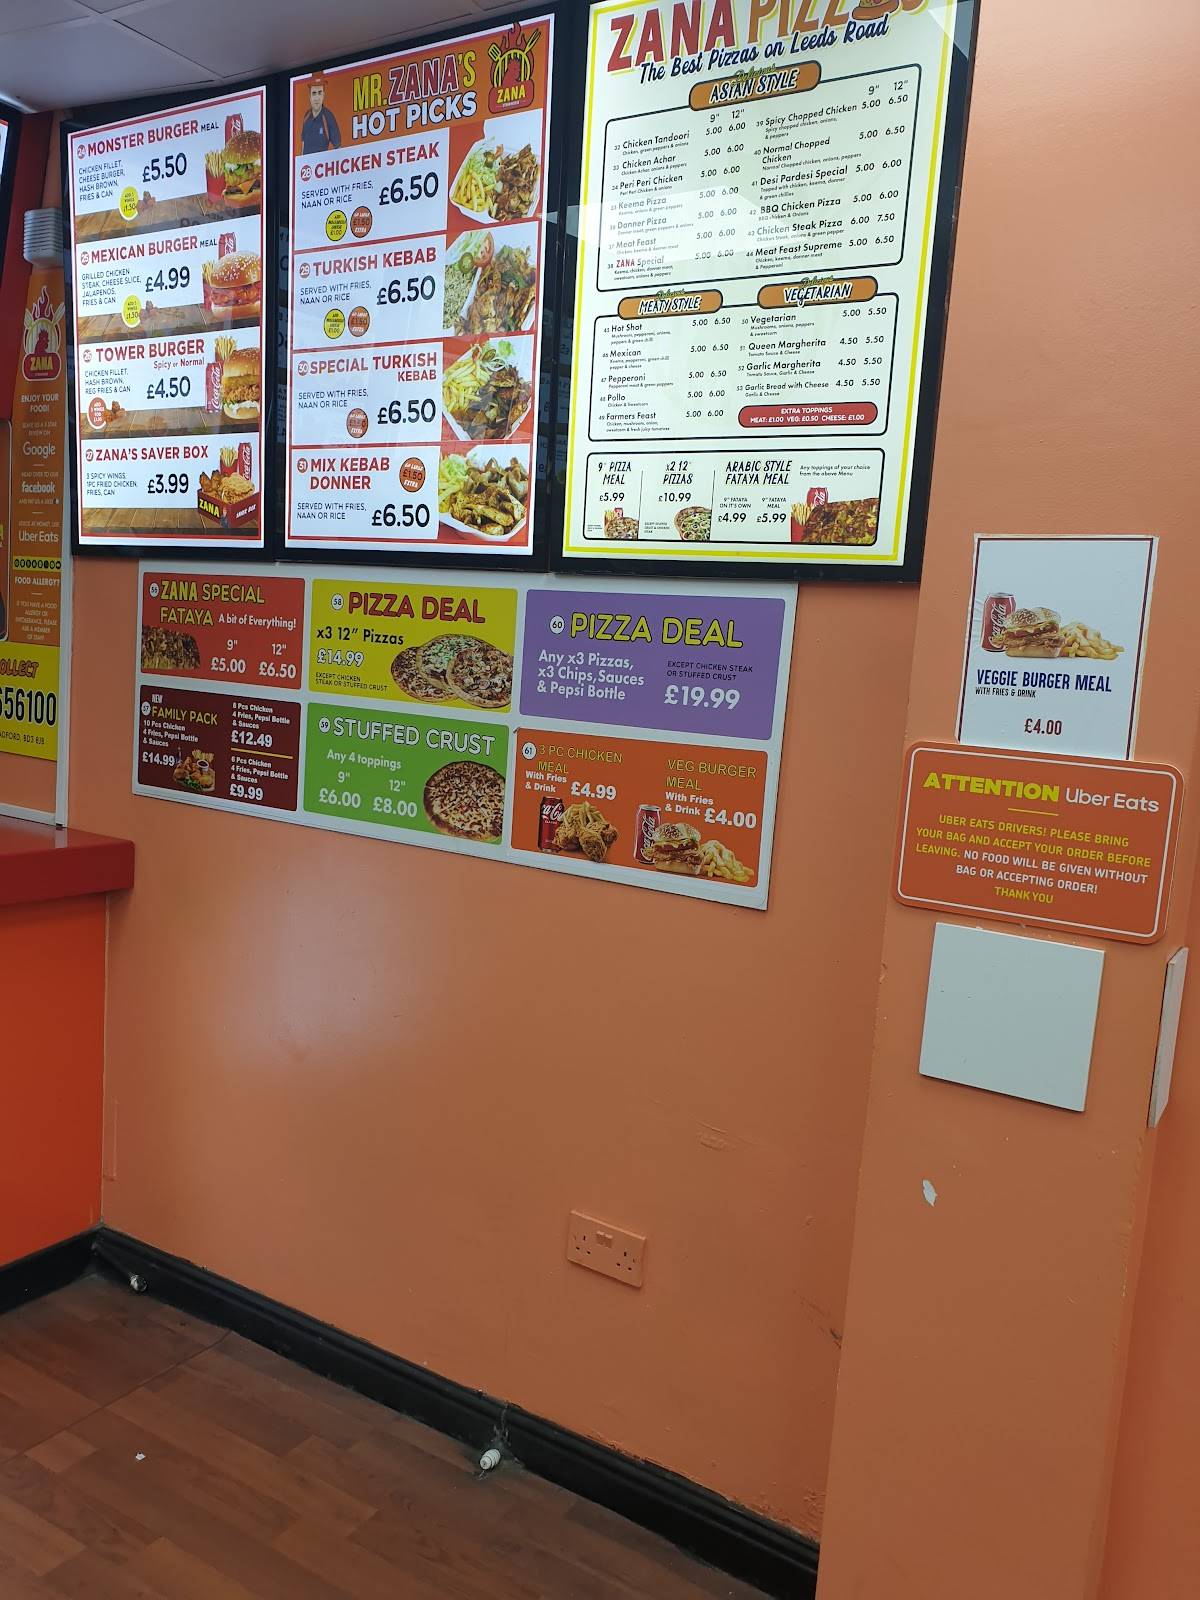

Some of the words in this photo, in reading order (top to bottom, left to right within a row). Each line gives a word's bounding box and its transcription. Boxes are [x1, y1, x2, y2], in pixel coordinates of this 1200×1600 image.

[607, 0, 735, 72] ZANA
[640, 62, 665, 84] The
[672, 54, 702, 77] Best
[709, 46, 758, 69] Pizzas
[765, 41, 783, 58] on
[791, 25, 836, 54] Leeds
[844, 15, 889, 44] Road
[497, 85, 525, 103] ZANA
[710, 80, 754, 104] ASIAN
[757, 70, 799, 95] STYLE
[862, 100, 880, 109] 5.00
[889, 94, 908, 105] 6.50
[352, 108, 400, 139] HOT
[406, 91, 477, 128] PICKS
[766, 116, 786, 126] Spicy
[788, 110, 823, 123] Chopped
[826, 105, 857, 115] Chicken
[88, 132, 144, 156] MONSTER
[148, 120, 198, 143] BURGER
[201, 122, 219, 132] MEAL
[623, 139, 652, 149] Chicken
[655, 131, 689, 143] Tandoori
[142, 153, 187, 183] £5.50
[314, 153, 381, 178] CHICKEN
[387, 142, 439, 166] STEAK
[760, 175, 778, 185] Desi
[781, 171, 812, 183] Pardesi
[816, 165, 848, 179] Special
[302, 188, 329, 199] SERVED
[331, 184, 350, 193] WITH
[379, 172, 439, 205] £6.50
[302, 200, 322, 208] NAAN
[337, 195, 352, 203] RICE
[92, 244, 144, 263] MEXICAN
[148, 236, 198, 256] BURGER
[200, 239, 217, 248] MEAL
[313, 254, 377, 276] TURKISH
[383, 247, 436, 267] KEBAB
[145, 266, 190, 293] £4.99
[376, 275, 436, 305] £6.50
[785, 284, 851, 304] VEGETARIAN
[96, 345, 144, 362] TOWER
[149, 339, 205, 358] BURGER
[310, 358, 368, 374] SPECIAL
[373, 352, 437, 369] TURKISH
[398, 369, 436, 382] KEBAB
[146, 376, 191, 399] £4.50
[377, 398, 436, 424] £6.50
[23, 441, 56, 458] Google
[95, 448, 138, 461] ZANA'S
[141, 446, 179, 460] SAVER
[183, 445, 208, 458] BOX
[311, 458, 336, 472] MIX
[340, 457, 390, 471] KEBAB
[726, 461, 760, 471] ARABIC
[764, 461, 792, 471] STYLE
[21, 482, 55, 493] facebook
[148, 473, 189, 494] £3.99
[310, 476, 371, 489] DONNER
[725, 473, 759, 485] FATAYA
[763, 473, 789, 485] MEAL
[371, 503, 430, 527] £6.50
[19, 531, 37, 542] Uber
[39, 531, 59, 542] Eats
[161, 581, 197, 601] ZANA
[202, 584, 265, 603] SPECIAL
[160, 607, 213, 626] FATAYA
[348, 592, 414, 618] PIZZA
[421, 596, 485, 623] DEAL
[219, 614, 224, 622] A
[226, 614, 236, 623] bit
[239, 615, 248, 624] of
[249, 615, 296, 631] Everything!
[570, 612, 652, 643] PIZZA
[662, 617, 743, 648] DEAL
[317, 627, 333, 639] x3
[363, 629, 403, 645] Pizzas
[211, 657, 246, 673] £5.00
[317, 649, 364, 667] £14.99
[538, 650, 563, 666] Any
[568, 653, 584, 664] x3
[588, 652, 634, 670] Pizzas,
[259, 661, 296, 678] £6.50
[977, 669, 1018, 686] VEGGIE
[1023, 672, 1069, 689] BURGER
[1075, 674, 1112, 692] MEAL
[537, 681, 547, 693] &
[550, 683, 584, 698] Pepsi
[588, 684, 625, 701] Bottle
[664, 685, 740, 710] £19.99
[975, 687, 990, 695] WITH
[992, 688, 1008, 696] FRIES
[1018, 690, 1036, 698] DRINK
[152, 706, 187, 721] FAMILY
[190, 711, 217, 725] PACK
[333, 717, 420, 746] STUFFED
[426, 729, 496, 756] CRUST
[1024, 718, 1062, 735] £4.00
[231, 730, 272, 747] £12.49
[142, 752, 175, 766] £14.99
[327, 750, 346, 763] Any
[349, 752, 355, 761] 4
[358, 753, 401, 771] toppings
[539, 745, 545, 754] 3
[549, 746, 563, 757] PC
[567, 748, 622, 764] CHICKEN
[538, 761, 568, 773] MEAL
[668, 759, 694, 772] VEG
[699, 762, 756, 779] BURGER
[230, 784, 263, 800] £9.99
[571, 781, 616, 800] £4.99
[666, 777, 702, 791] MEAL
[923, 772, 1059, 802] ATTENTION
[1066, 787, 1110, 807] Uber
[1114, 793, 1160, 812] Eats
[319, 788, 361, 808] £6.00
[373, 797, 417, 817] £8.00
[704, 808, 756, 828] £4.00
[939, 815, 966, 827] UBER
[970, 818, 994, 830] EATS
[998, 822, 1046, 836] DRIVERS!
[1050, 829, 1091, 842] PLEASE
[1095, 834, 1129, 847] BRING
[916, 827, 943, 839] YOUR
[946, 831, 966, 842] BAG
[969, 835, 990, 845] AND
[993, 838, 1031, 850] ACCEPT
[1035, 843, 1062, 855] YOUR
[1066, 848, 1103, 861] ORDER
[1107, 853, 1151, 867] BEFORE
[915, 843, 960, 857] LEAVING.
[964, 849, 978, 860] NO
[982, 852, 1009, 864] FOOD
[1013, 856, 1038, 869] WILL
[1042, 860, 1055, 871] BE
[1059, 863, 1091, 876] GIVEN
[1095, 868, 1148, 884] WITHOUT
[956, 865, 976, 876] BAG
[980, 868, 993, 879] OR
[997, 871, 1053, 887] ACCEPTING
[1057, 879, 1097, 894] ORDER!
[995, 886, 1030, 900] THANK
[1033, 891, 1053, 903] YOU
